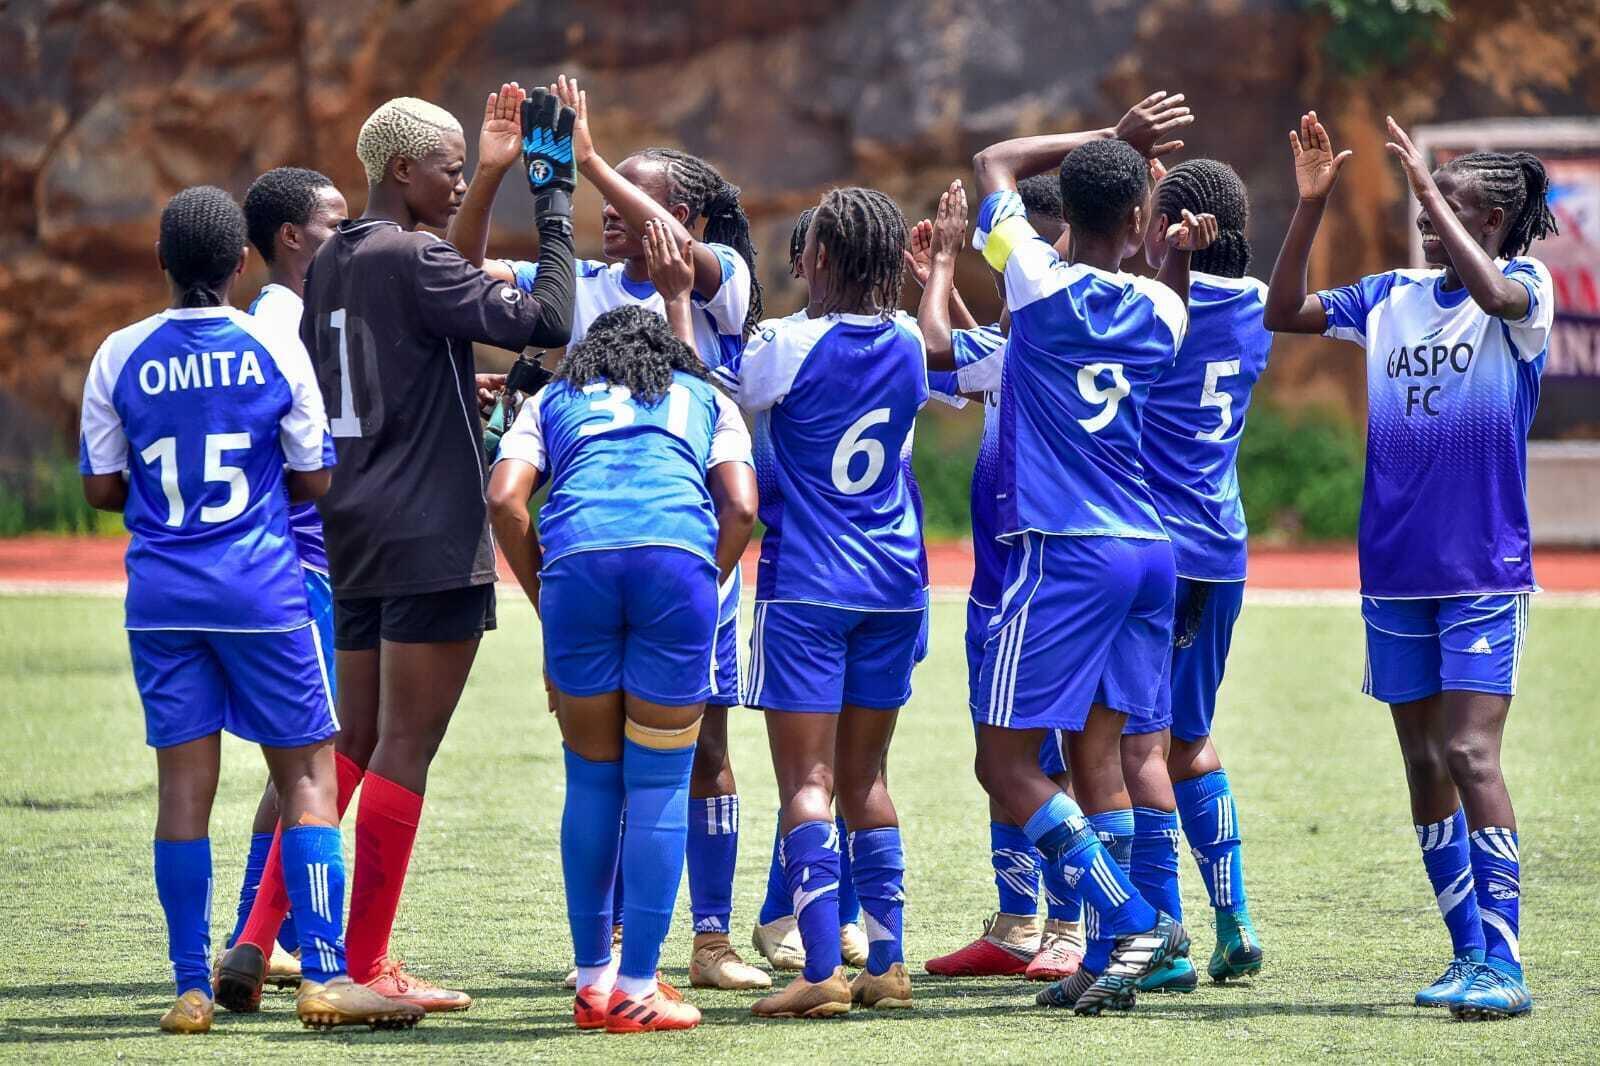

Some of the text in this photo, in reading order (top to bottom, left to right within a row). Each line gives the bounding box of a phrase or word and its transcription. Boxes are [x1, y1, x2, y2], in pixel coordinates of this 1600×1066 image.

[139, 350, 266, 396] OMITA
[1386, 342, 1474, 379] GASPO
[577, 382, 691, 437] 31
[1076, 362, 1132, 434] 9
[1194, 359, 1241, 441] 5
[1405, 385, 1441, 417] FC
[140, 432, 252, 528] 15
[830, 407, 892, 496] 6
